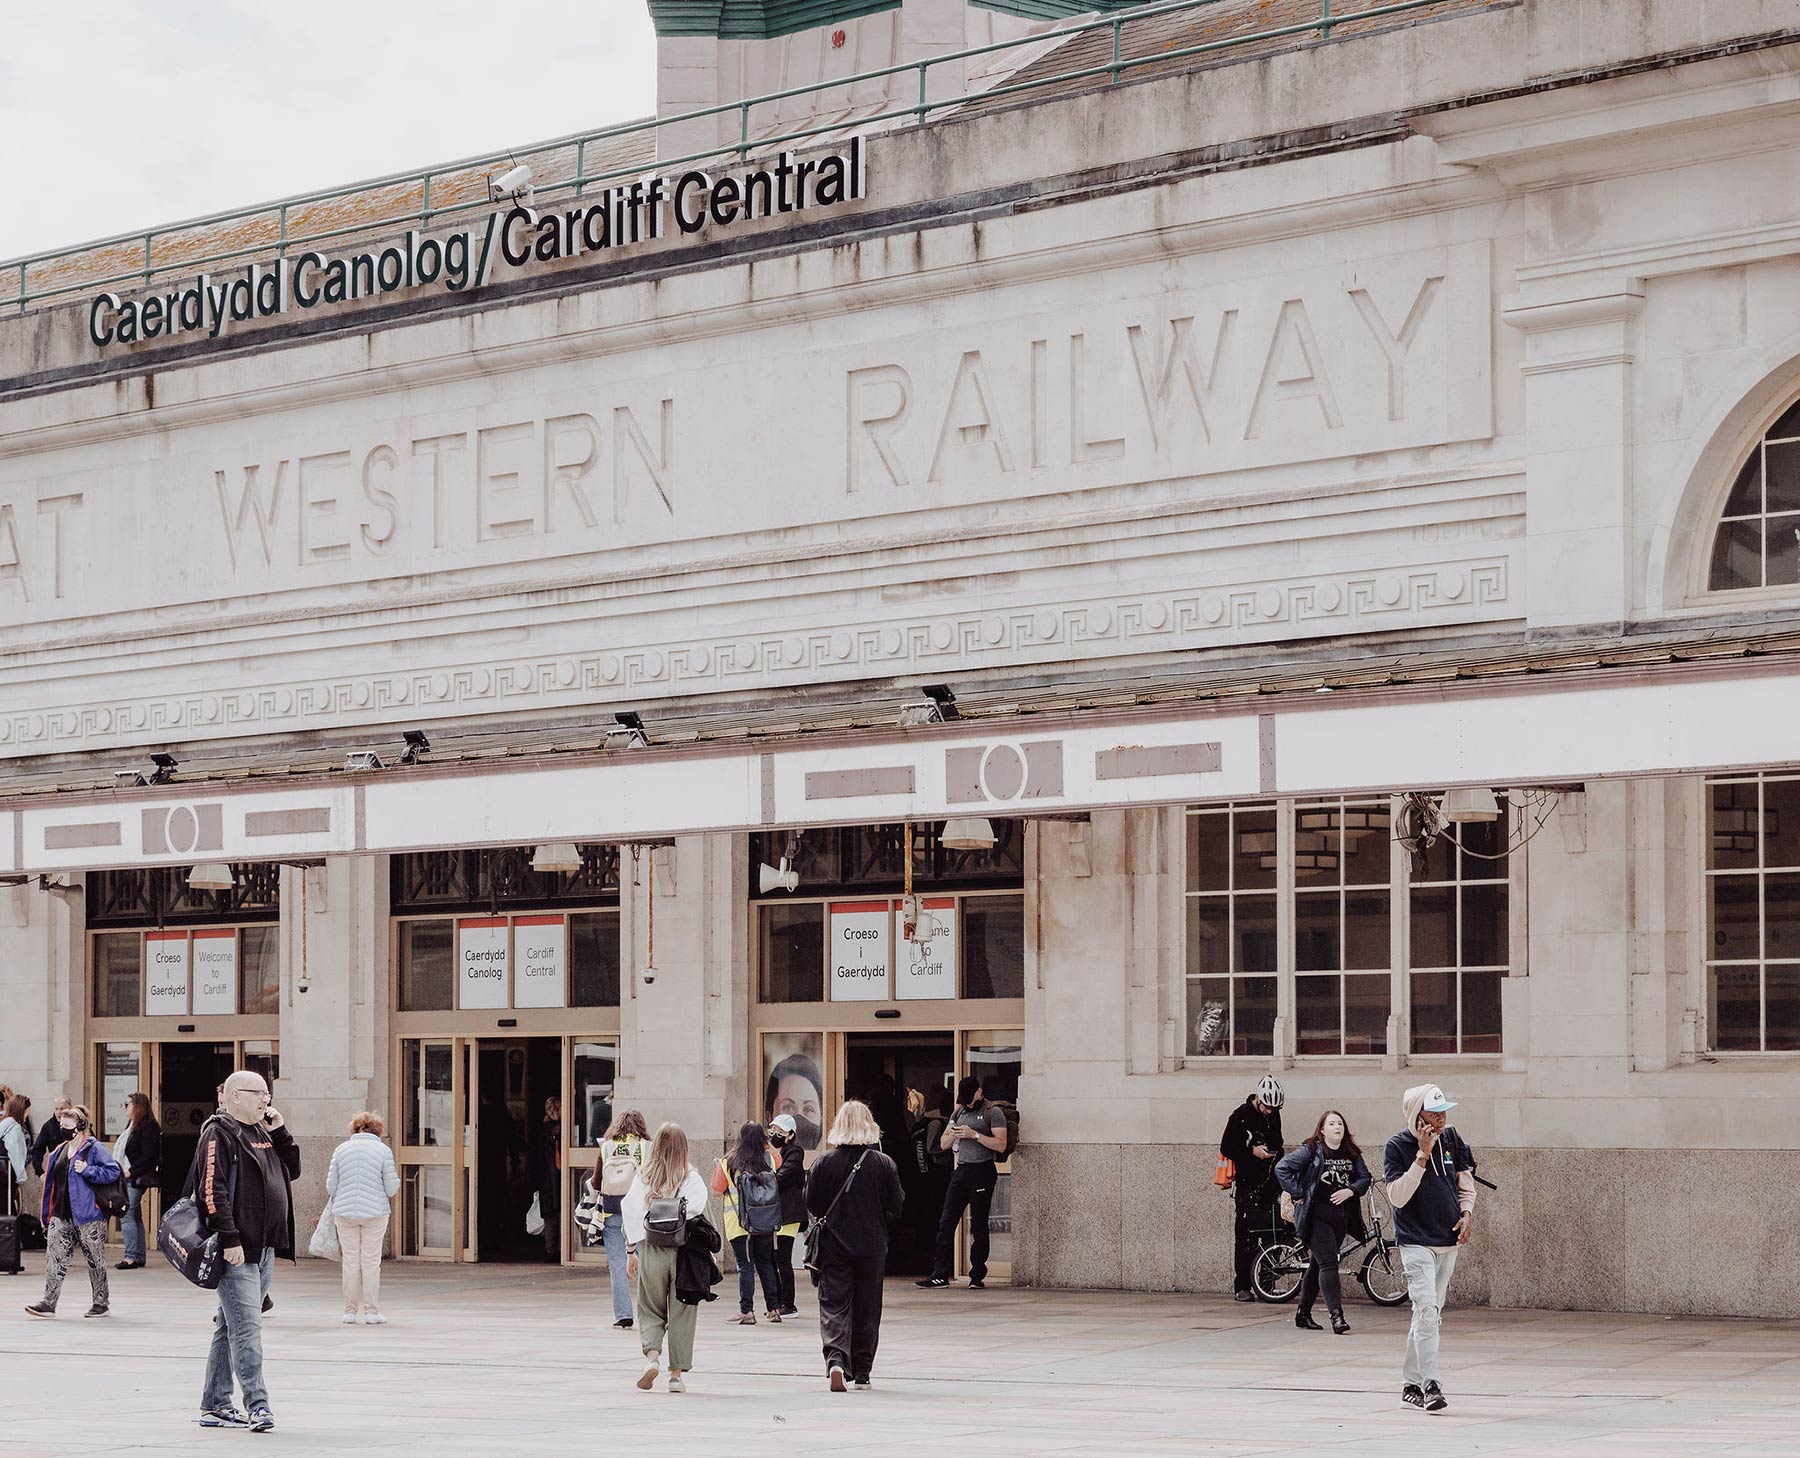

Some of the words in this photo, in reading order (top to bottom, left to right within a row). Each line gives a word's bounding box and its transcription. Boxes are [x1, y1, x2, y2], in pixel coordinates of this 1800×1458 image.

[90, 258, 287, 347] Caerdydd
[674, 135, 866, 235] Central
[214, 398, 674, 574] WESTERN
[846, 276, 1446, 494] RAILWAY
[843, 927, 879, 940] Croeso
[155, 952, 181, 964] Croeso
[199, 951, 232, 963] Welcome
[465, 949, 505, 963] Caerdydd
[526, 947, 555, 959] Cardiff
[859, 946, 863, 958] i
[211, 968, 219, 979] to
[467, 967, 502, 980] Canolog
[525, 965, 556, 977] Central
[837, 965, 885, 981] Gaerdydd
[910, 962, 942, 976] Cardiff
[150, 984, 186, 998] Gaerdydd
[203, 983, 227, 996] Cardiff
